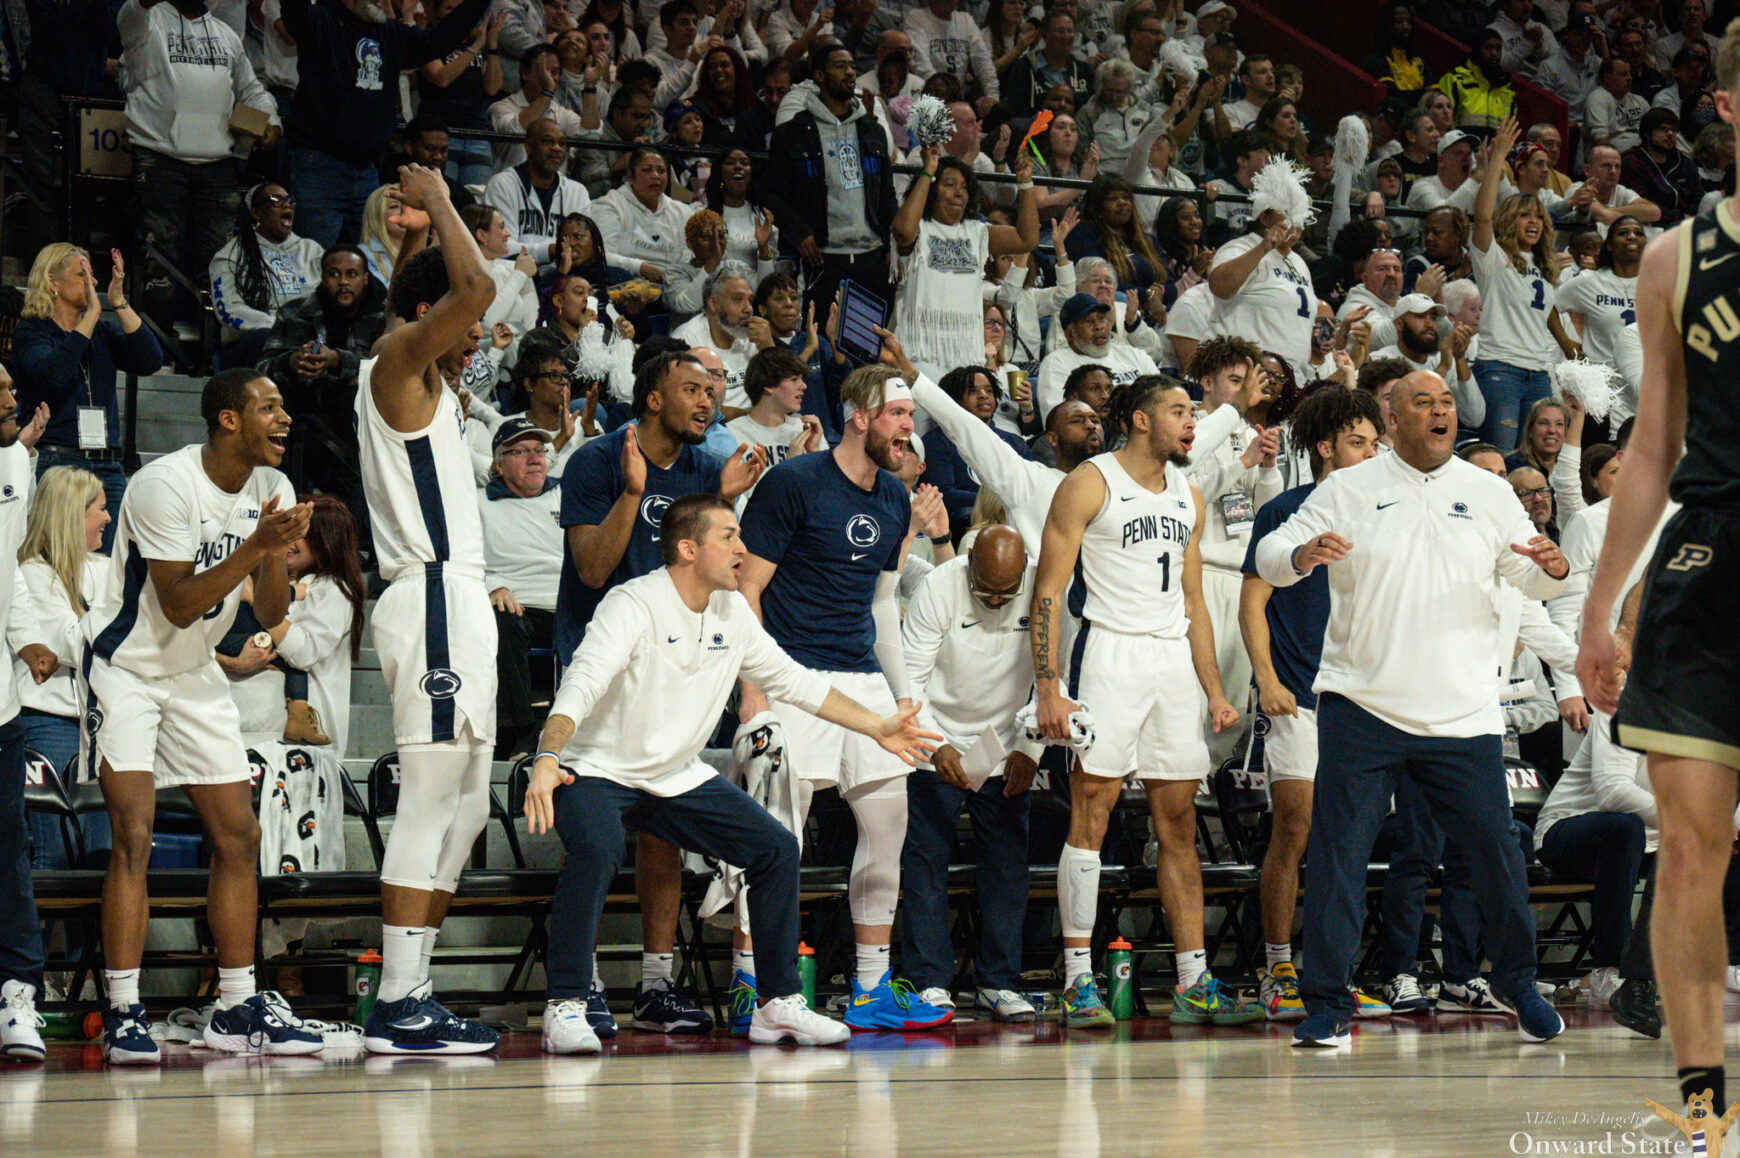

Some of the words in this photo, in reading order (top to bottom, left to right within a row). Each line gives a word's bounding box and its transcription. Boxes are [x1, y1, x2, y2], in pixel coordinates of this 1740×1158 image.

[167, 38, 197, 54] PENN
[946, 56, 957, 74] S
[519, 209, 545, 236] PENN
[1296, 286, 1310, 319] 1
[1530, 279, 1545, 311] 1
[1596, 294, 1625, 307] PENN
[1122, 515, 1156, 550] PENN
[1159, 515, 1192, 551] STAT
[1157, 551, 1170, 593] 1
[1667, 543, 1713, 572] P
